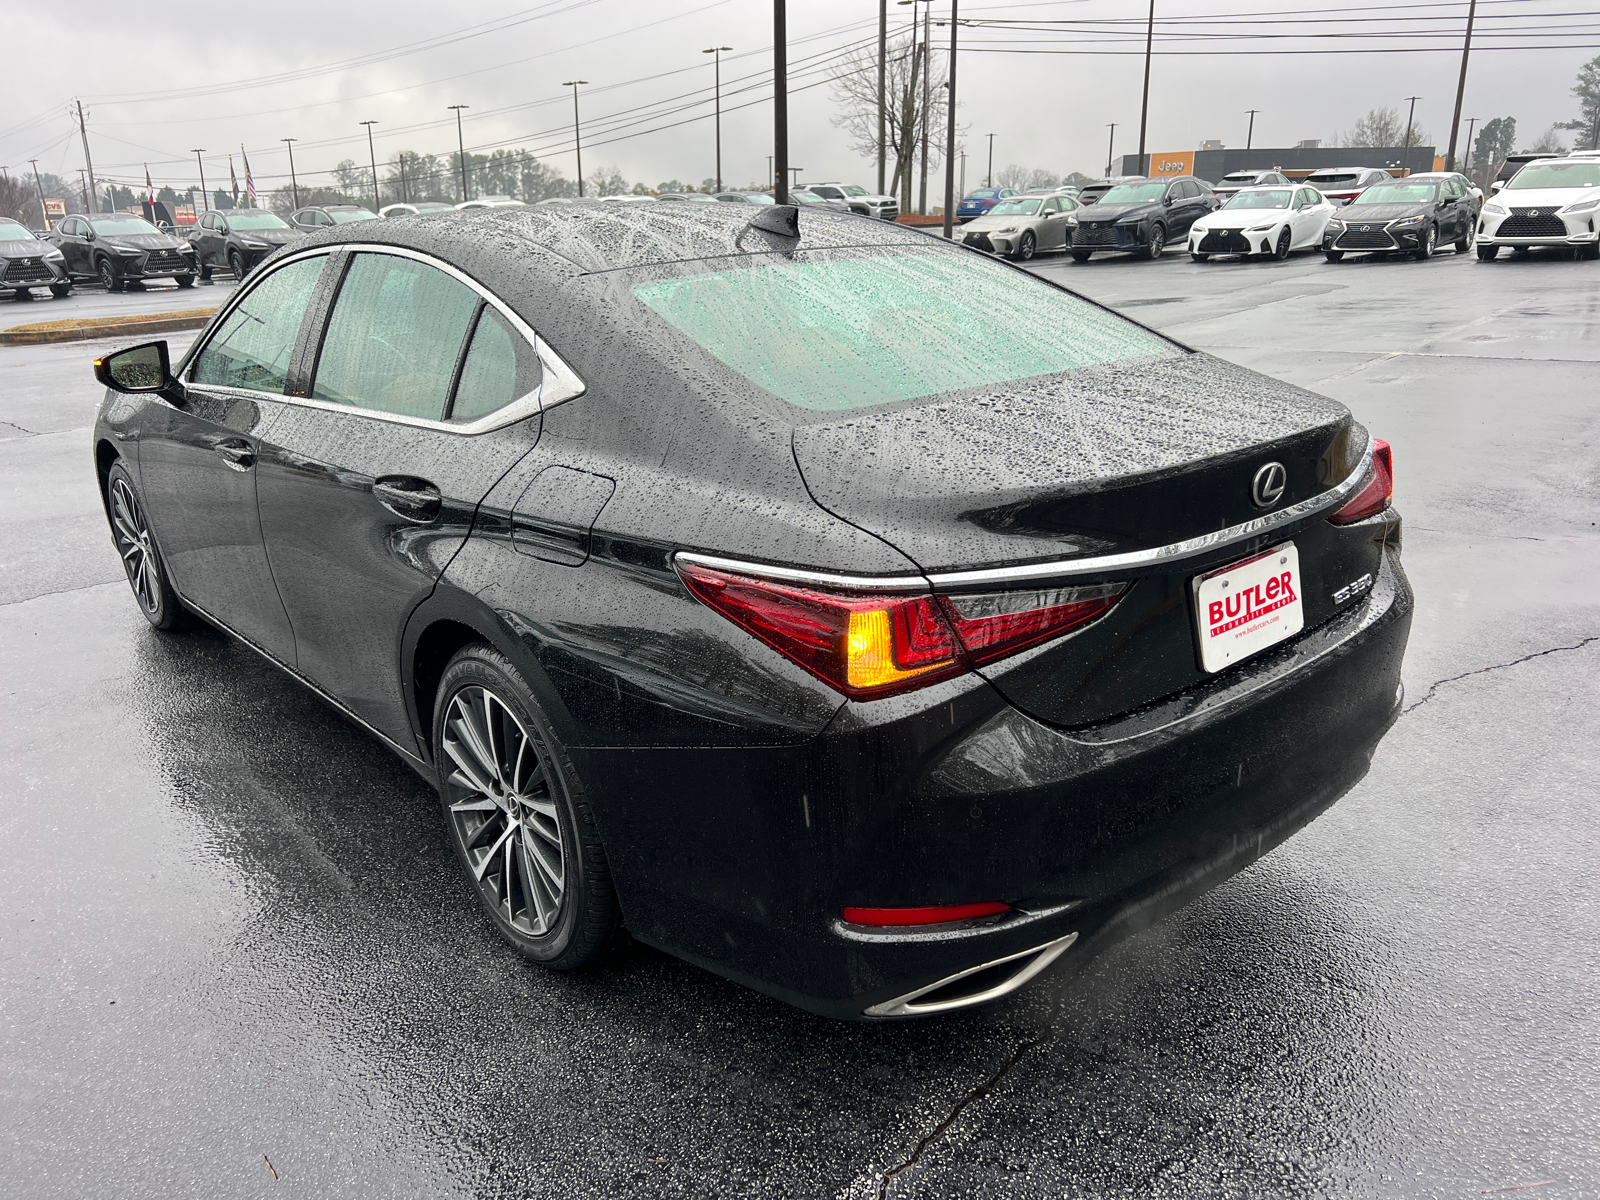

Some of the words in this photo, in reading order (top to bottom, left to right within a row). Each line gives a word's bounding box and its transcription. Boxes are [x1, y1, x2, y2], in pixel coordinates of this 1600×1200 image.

[1158, 160, 1184, 173] Jeep
[1210, 608, 1264, 637] AUTOMOTIVE
[1271, 594, 1295, 610] GROUP
[1234, 615, 1280, 639] www.butlercars.com
